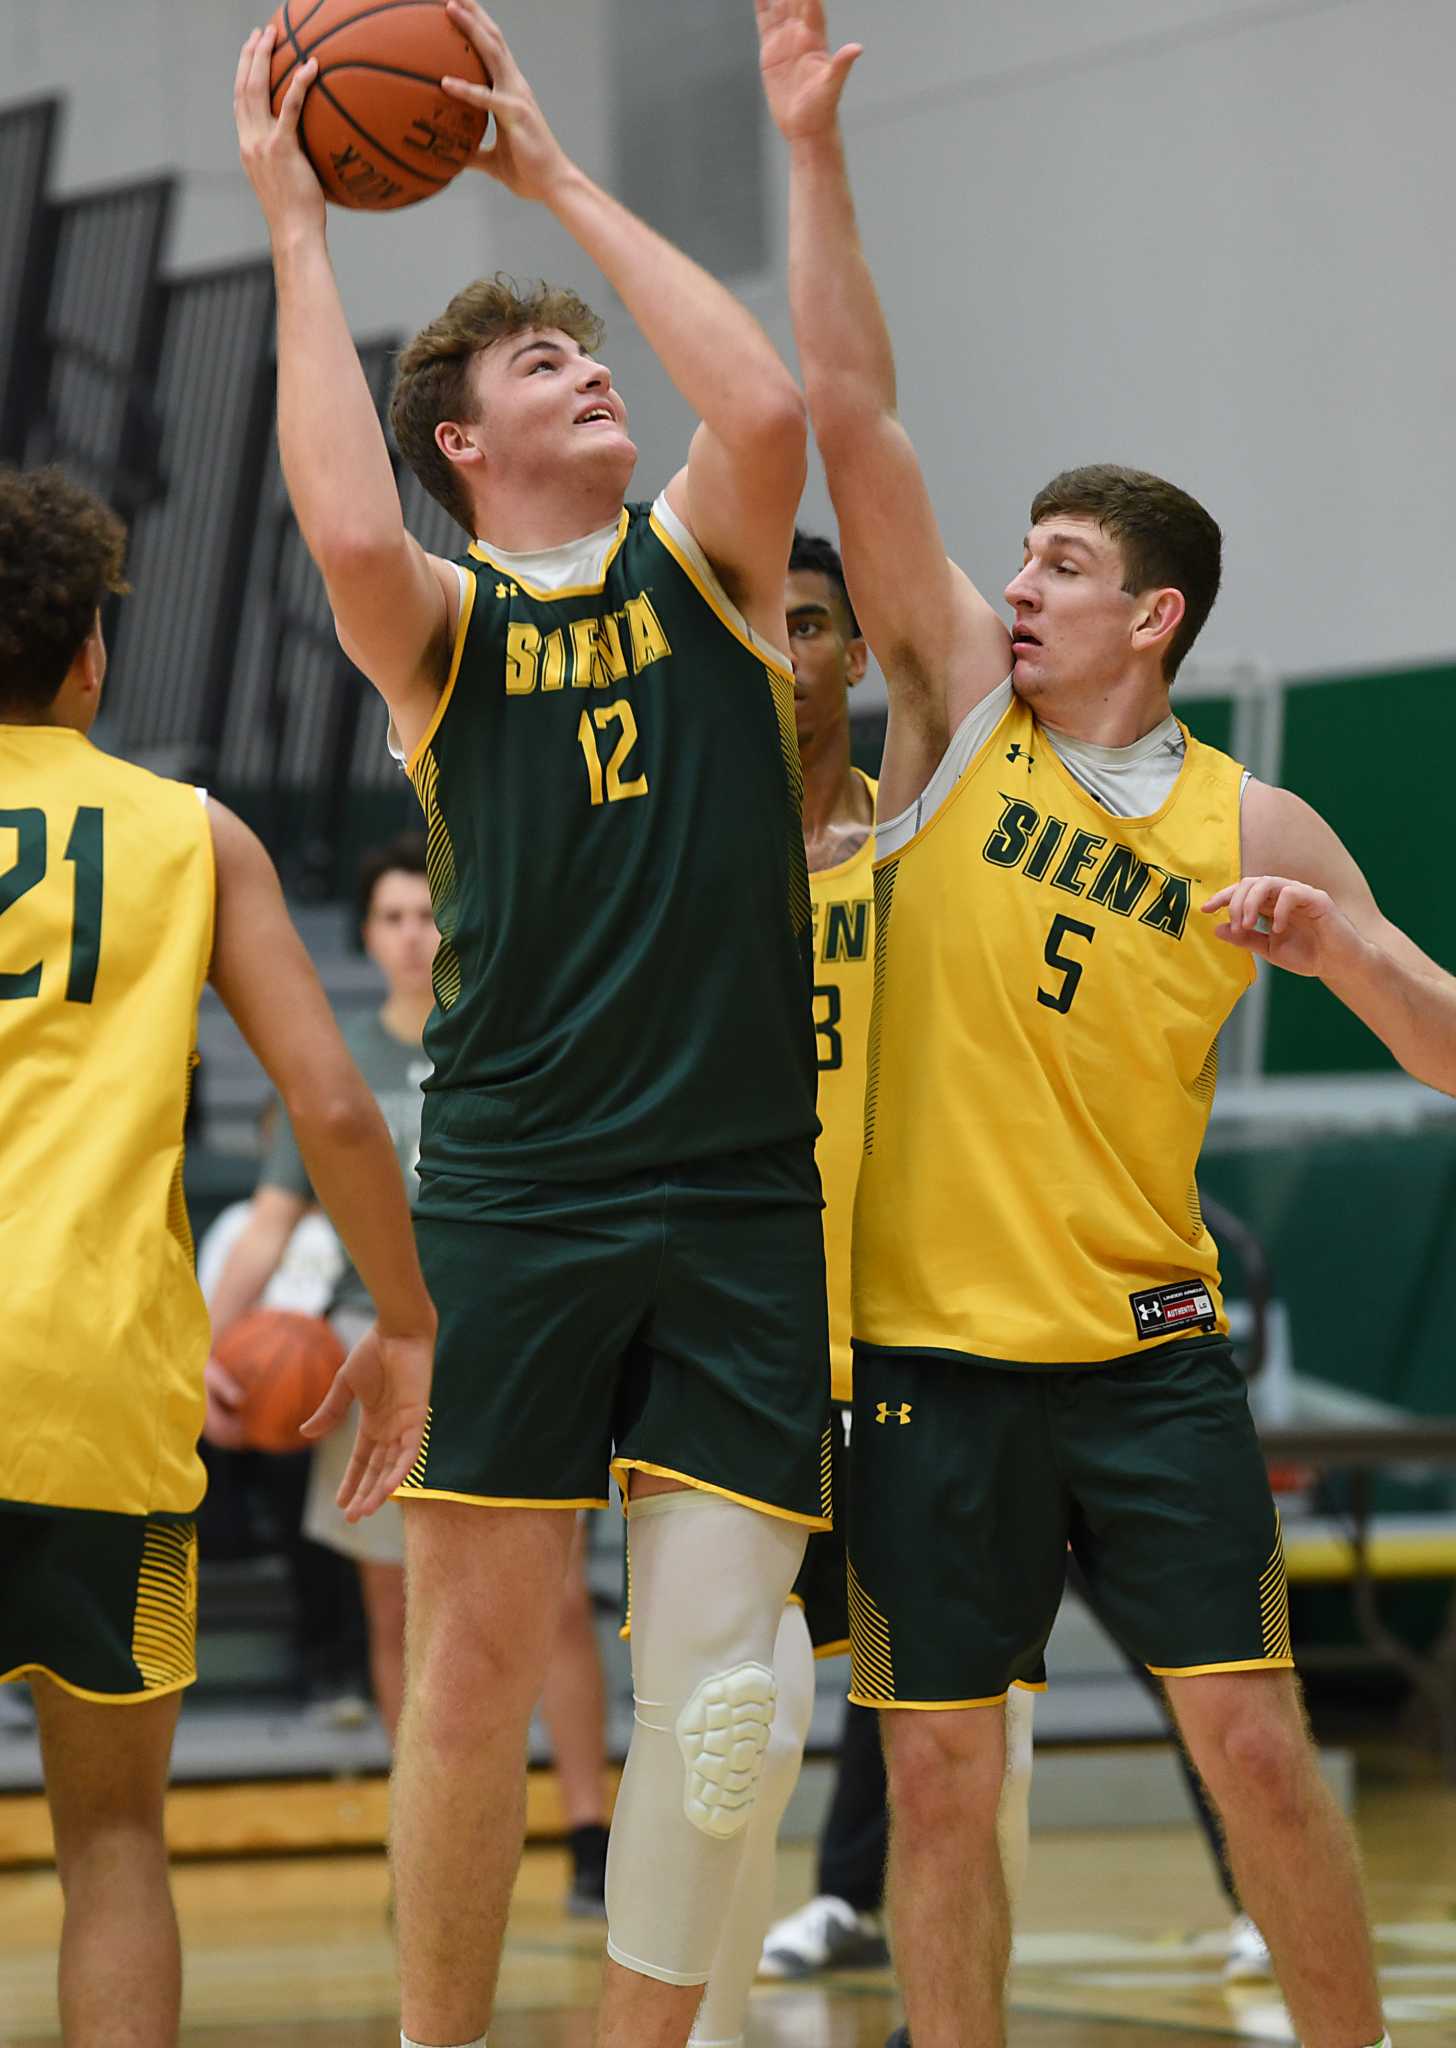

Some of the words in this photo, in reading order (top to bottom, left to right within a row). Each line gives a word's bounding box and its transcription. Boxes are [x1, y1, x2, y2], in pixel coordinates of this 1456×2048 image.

[506, 590, 672, 695] SIENA
[578, 699, 649, 806] 12
[0, 806, 104, 1005] 21
[983, 791, 1192, 941] SIENA
[1036, 913, 1096, 1015] 5
